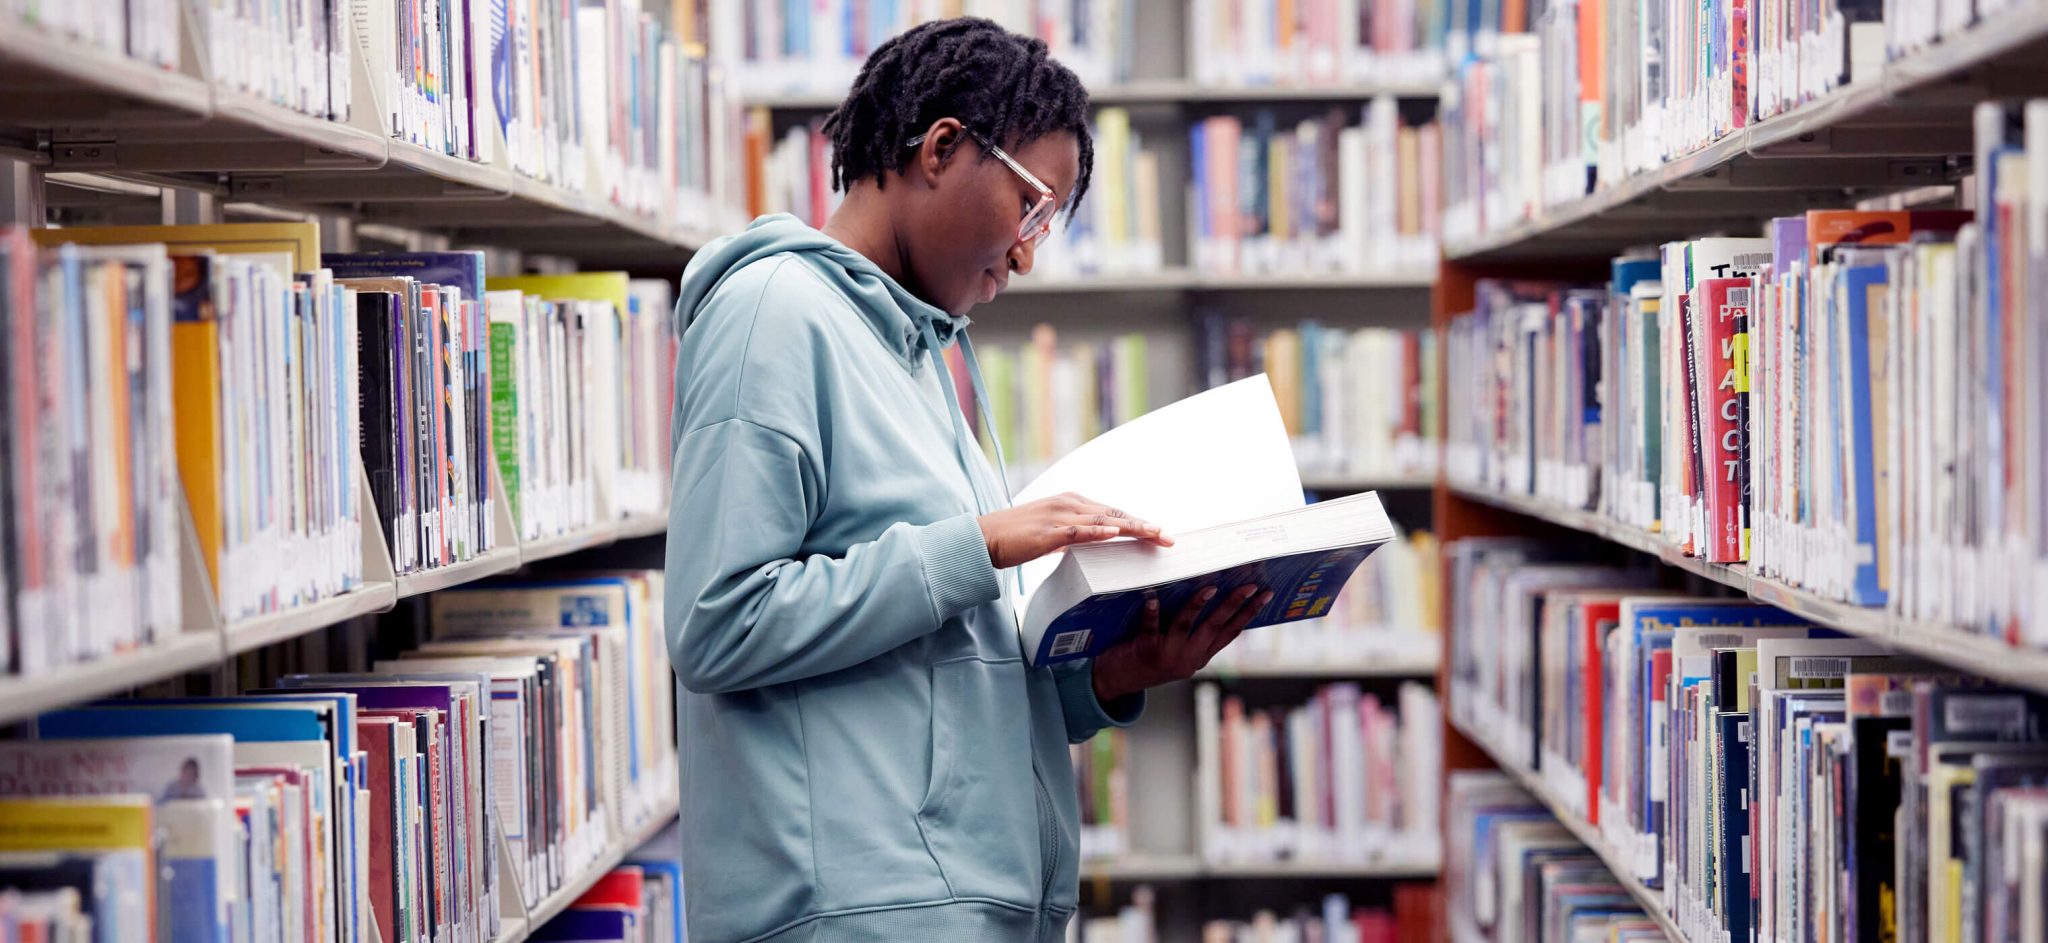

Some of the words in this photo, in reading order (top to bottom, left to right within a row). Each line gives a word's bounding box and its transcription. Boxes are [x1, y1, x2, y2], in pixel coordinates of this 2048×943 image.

[1685, 305, 1691, 326] An
[1687, 331, 1696, 384] Unquiet
[1690, 390, 1699, 454] Pedagogy
[434, 721, 443, 805] WOMEN
